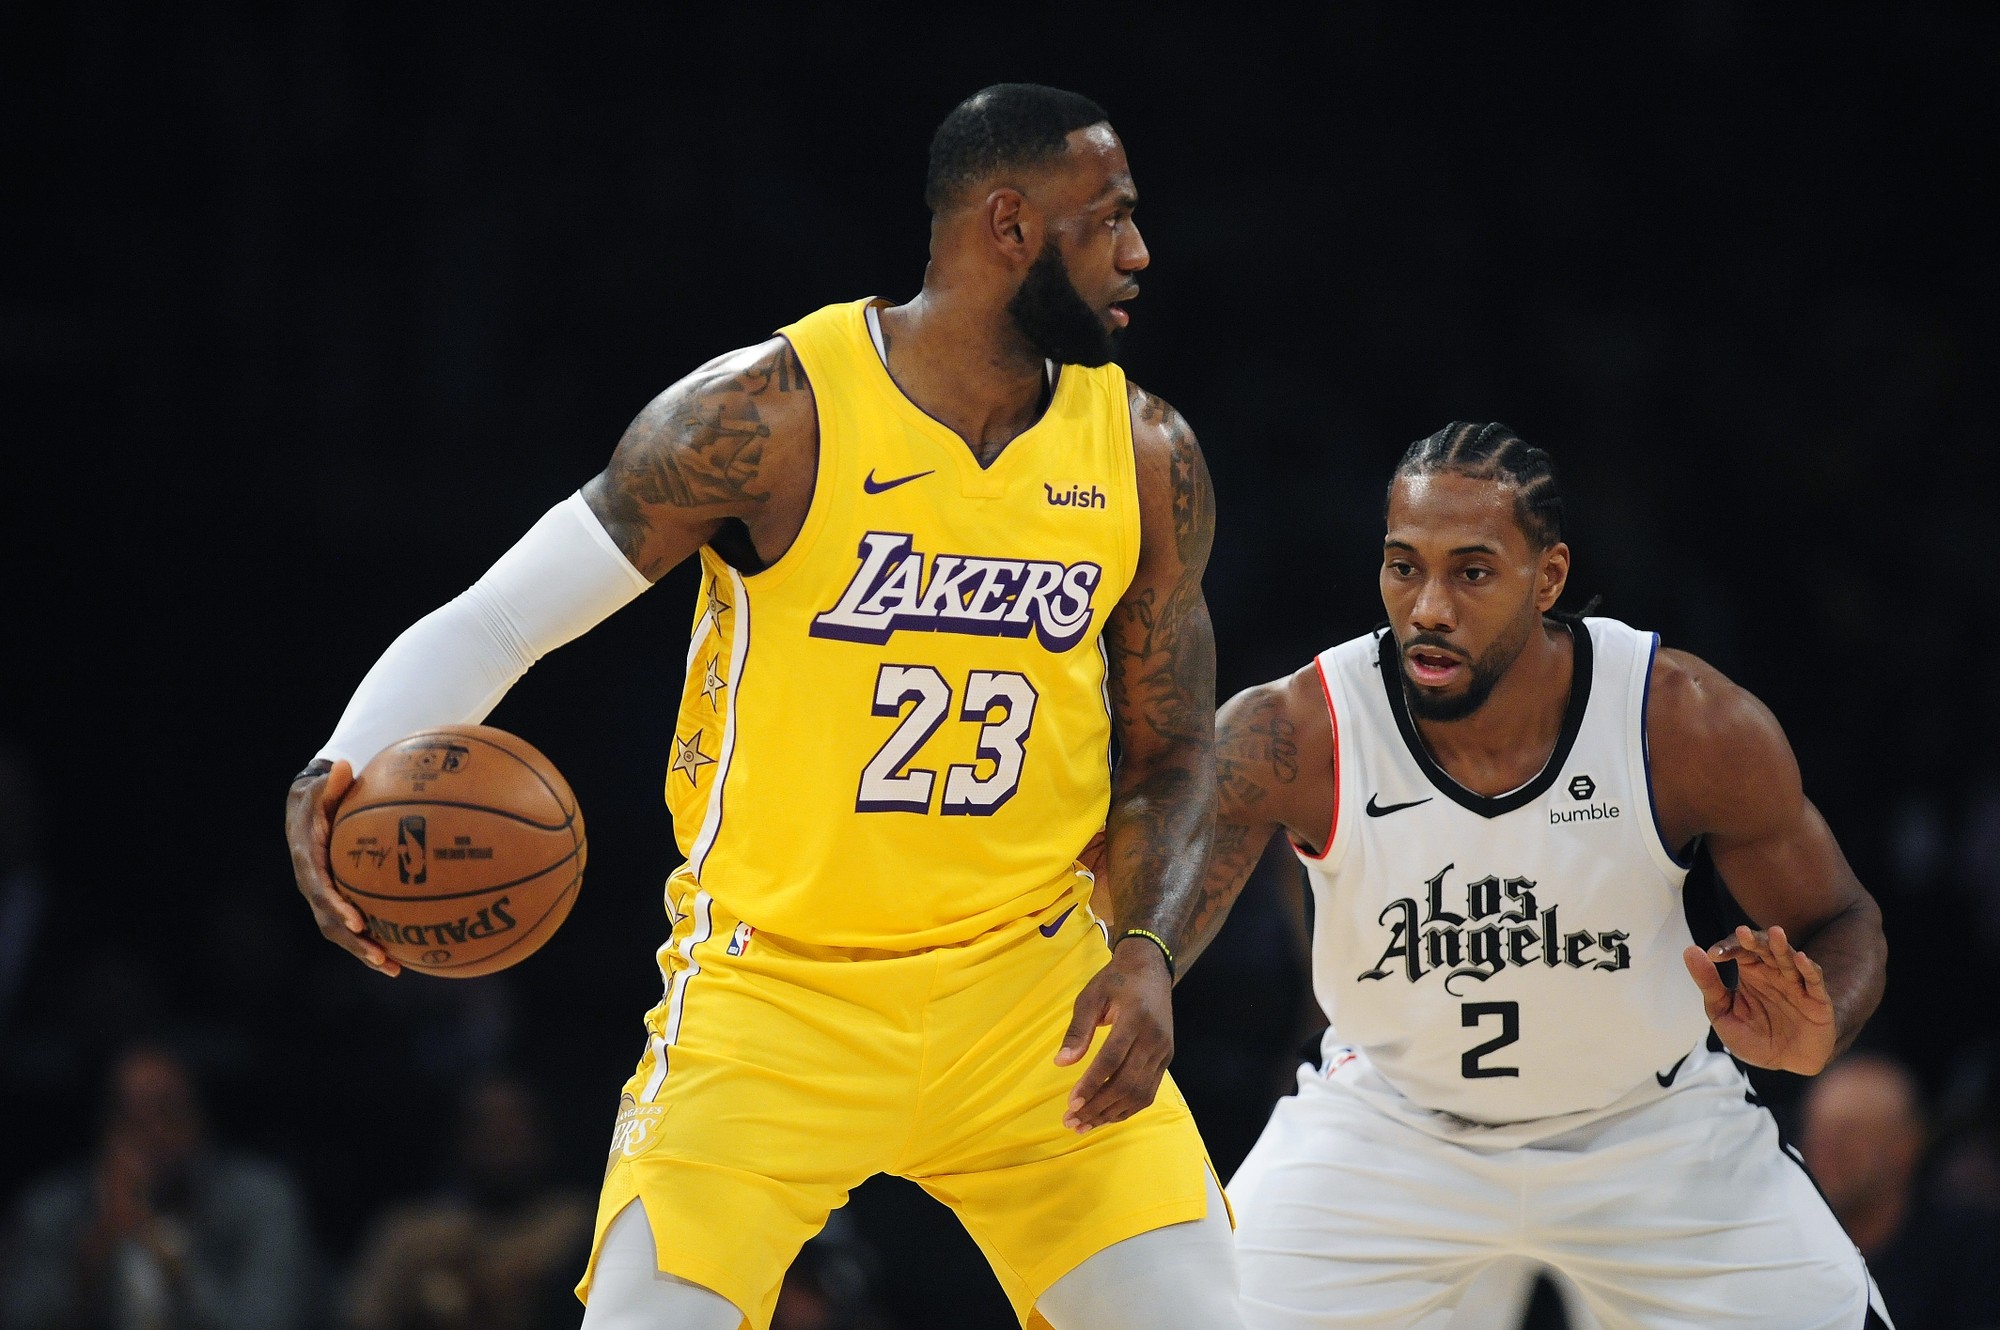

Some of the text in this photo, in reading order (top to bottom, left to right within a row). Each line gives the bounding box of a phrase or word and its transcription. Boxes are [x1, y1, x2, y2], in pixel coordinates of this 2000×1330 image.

[1044, 482, 1106, 509] wish
[809, 531, 1102, 654] LAKERS
[855, 663, 1039, 817] 23
[1549, 802, 1620, 825] bumble
[368, 896, 517, 946] SPALDIN
[1421, 863, 1538, 928] Los
[1357, 897, 1632, 998] Angeles
[1461, 1001, 1520, 1079] 2
